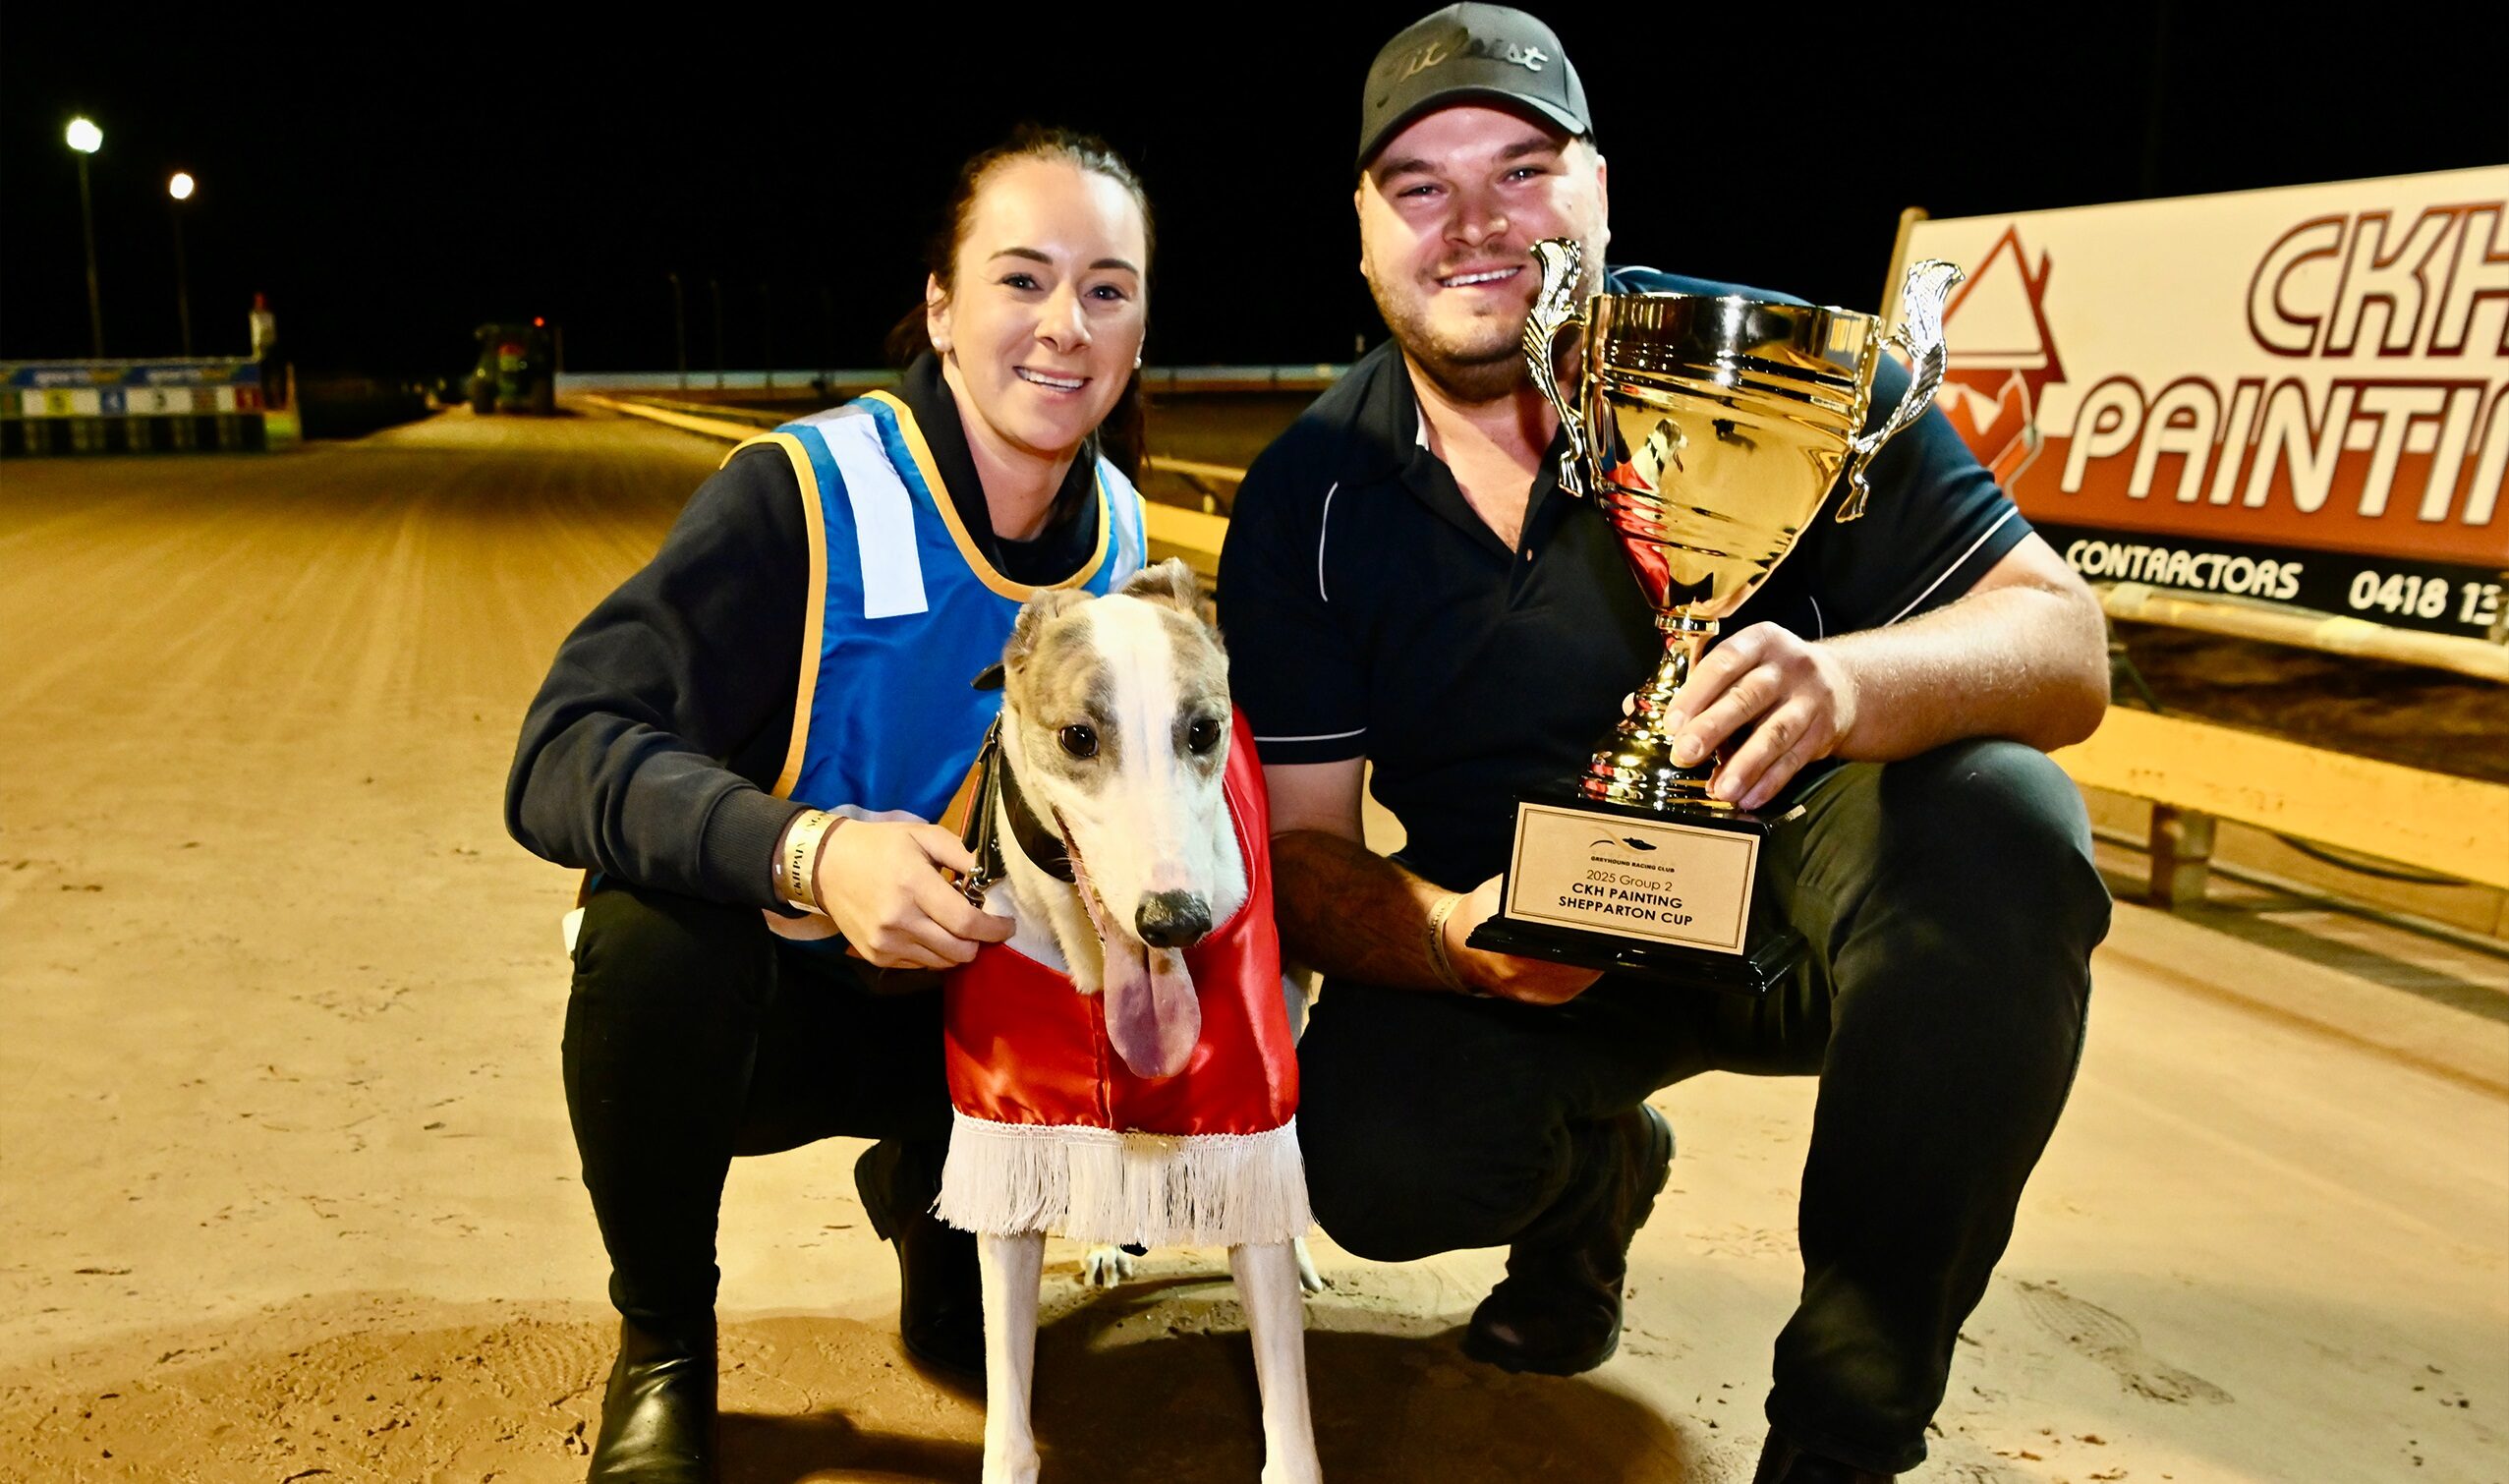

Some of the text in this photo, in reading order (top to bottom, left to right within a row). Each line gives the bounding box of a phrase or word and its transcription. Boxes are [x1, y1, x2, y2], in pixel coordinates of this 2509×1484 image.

[2248, 201, 2509, 358] CKH
[2066, 539, 2304, 600] CONTRACTORS
[2349, 570, 2449, 620] 0418
[1590, 856, 1630, 866] GREYHOUND
[1631, 862, 1656, 871] RACING
[1586, 870, 1673, 891] 2025 Group 2
[1571, 883, 1682, 909] CKH PAINTING
[1559, 895, 1693, 926] SHEPPARTON CUP
